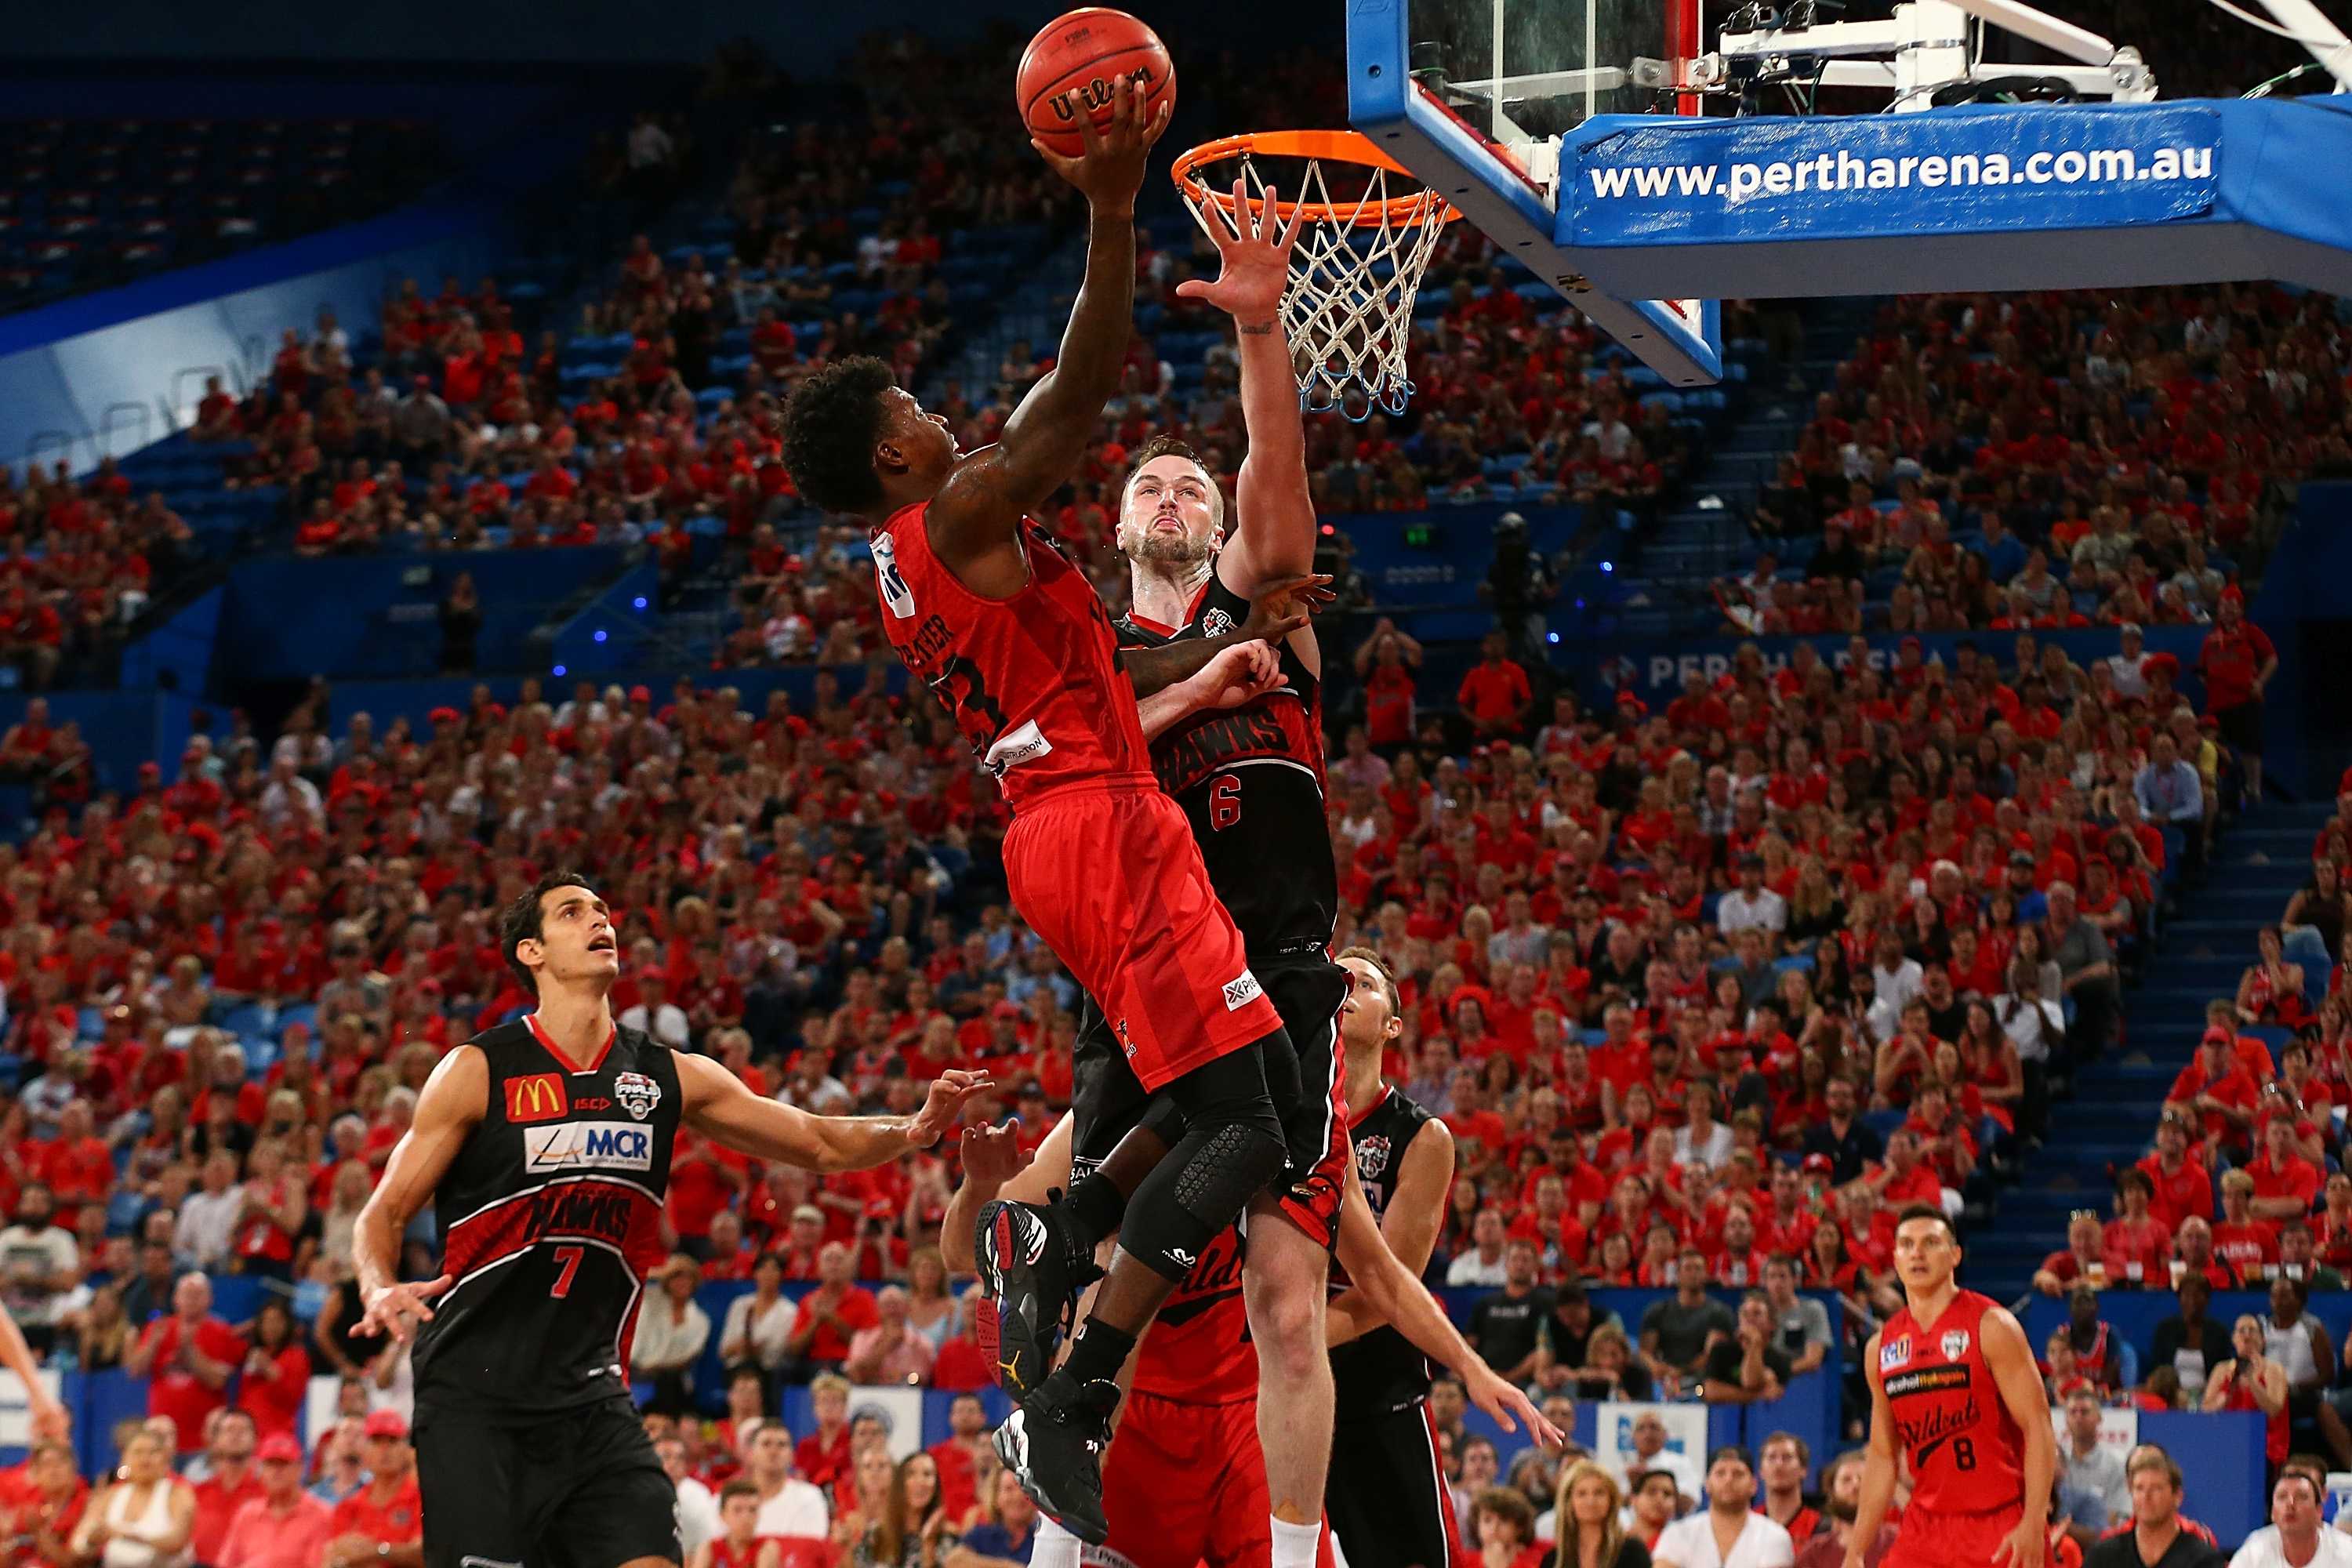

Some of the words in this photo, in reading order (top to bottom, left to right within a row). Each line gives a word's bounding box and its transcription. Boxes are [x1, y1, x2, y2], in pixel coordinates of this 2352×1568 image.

[1591, 144, 2213, 203] www.pertharena.com.au
[1650, 653, 1784, 688] PERH
[1209, 774, 1241, 832] 6
[586, 1129, 648, 1160] MCR
[522, 1192, 632, 1242] HAWKS
[550, 1246, 584, 1299] 7
[1954, 1436, 1976, 1472] 8
